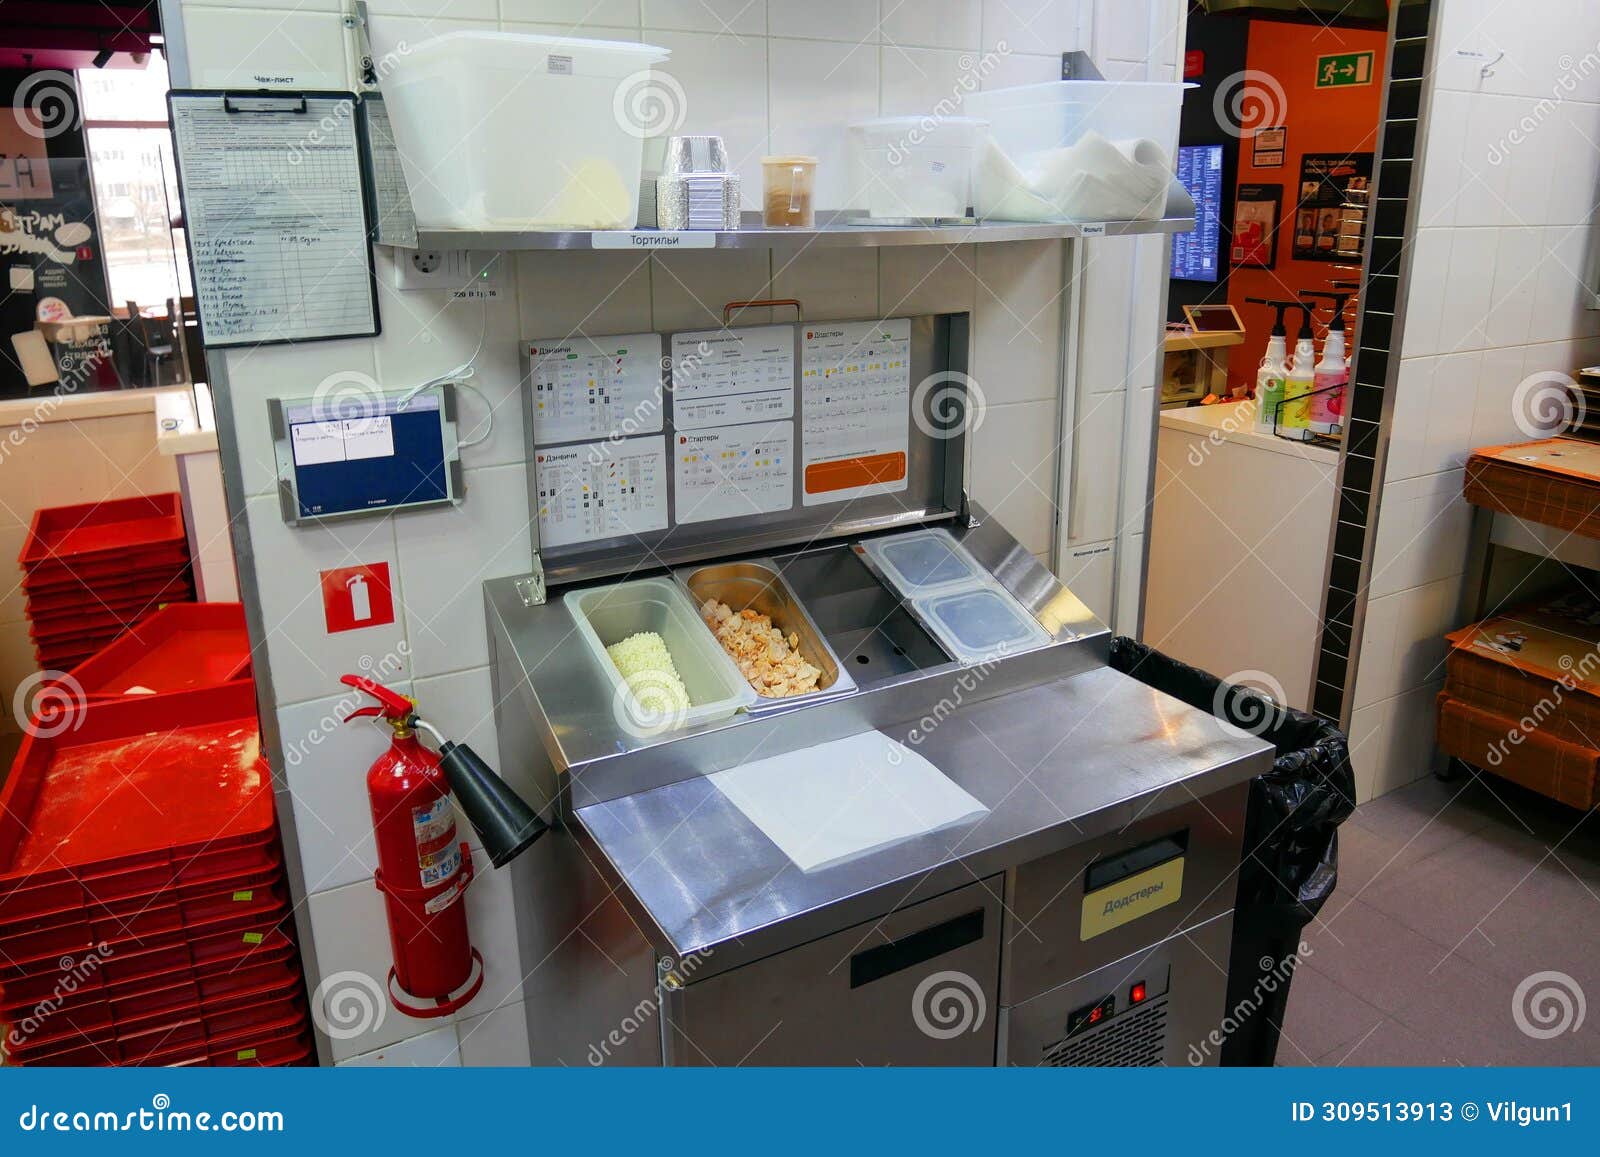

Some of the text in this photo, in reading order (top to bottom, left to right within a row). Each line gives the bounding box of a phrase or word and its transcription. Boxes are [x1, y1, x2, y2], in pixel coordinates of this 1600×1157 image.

[254, 75, 294, 84] Чек-лист
[630, 234, 679, 246] Тортильи
[1103, 882, 1164, 916] Додстеры
